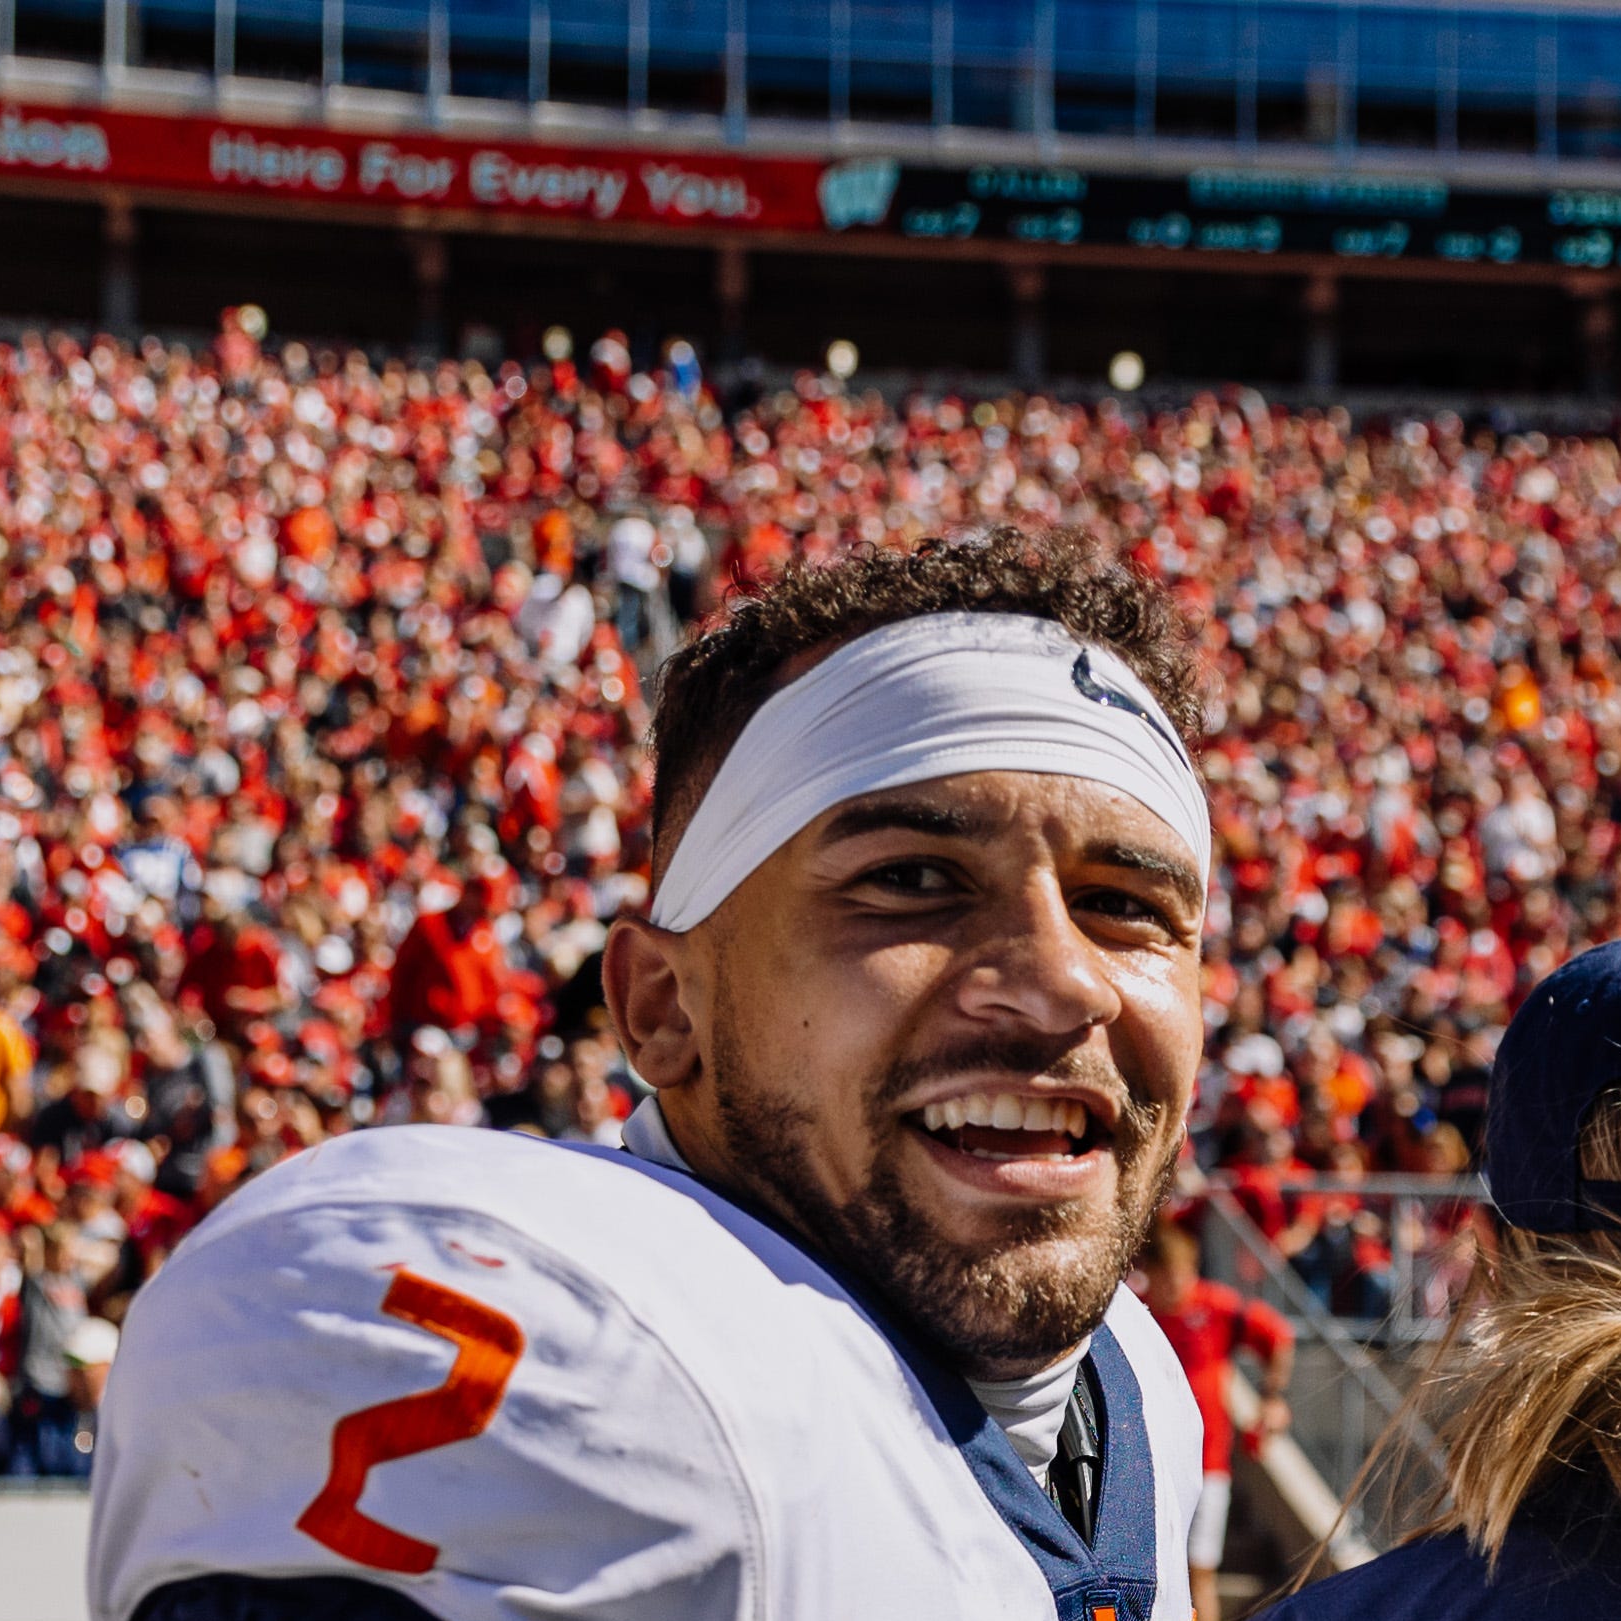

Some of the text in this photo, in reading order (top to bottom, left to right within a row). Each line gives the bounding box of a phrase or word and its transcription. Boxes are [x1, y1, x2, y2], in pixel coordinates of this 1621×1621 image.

[209, 128, 346, 192] Here
[358, 141, 456, 199] For
[467, 150, 627, 219] Every
[295, 1266, 526, 1576] 2
